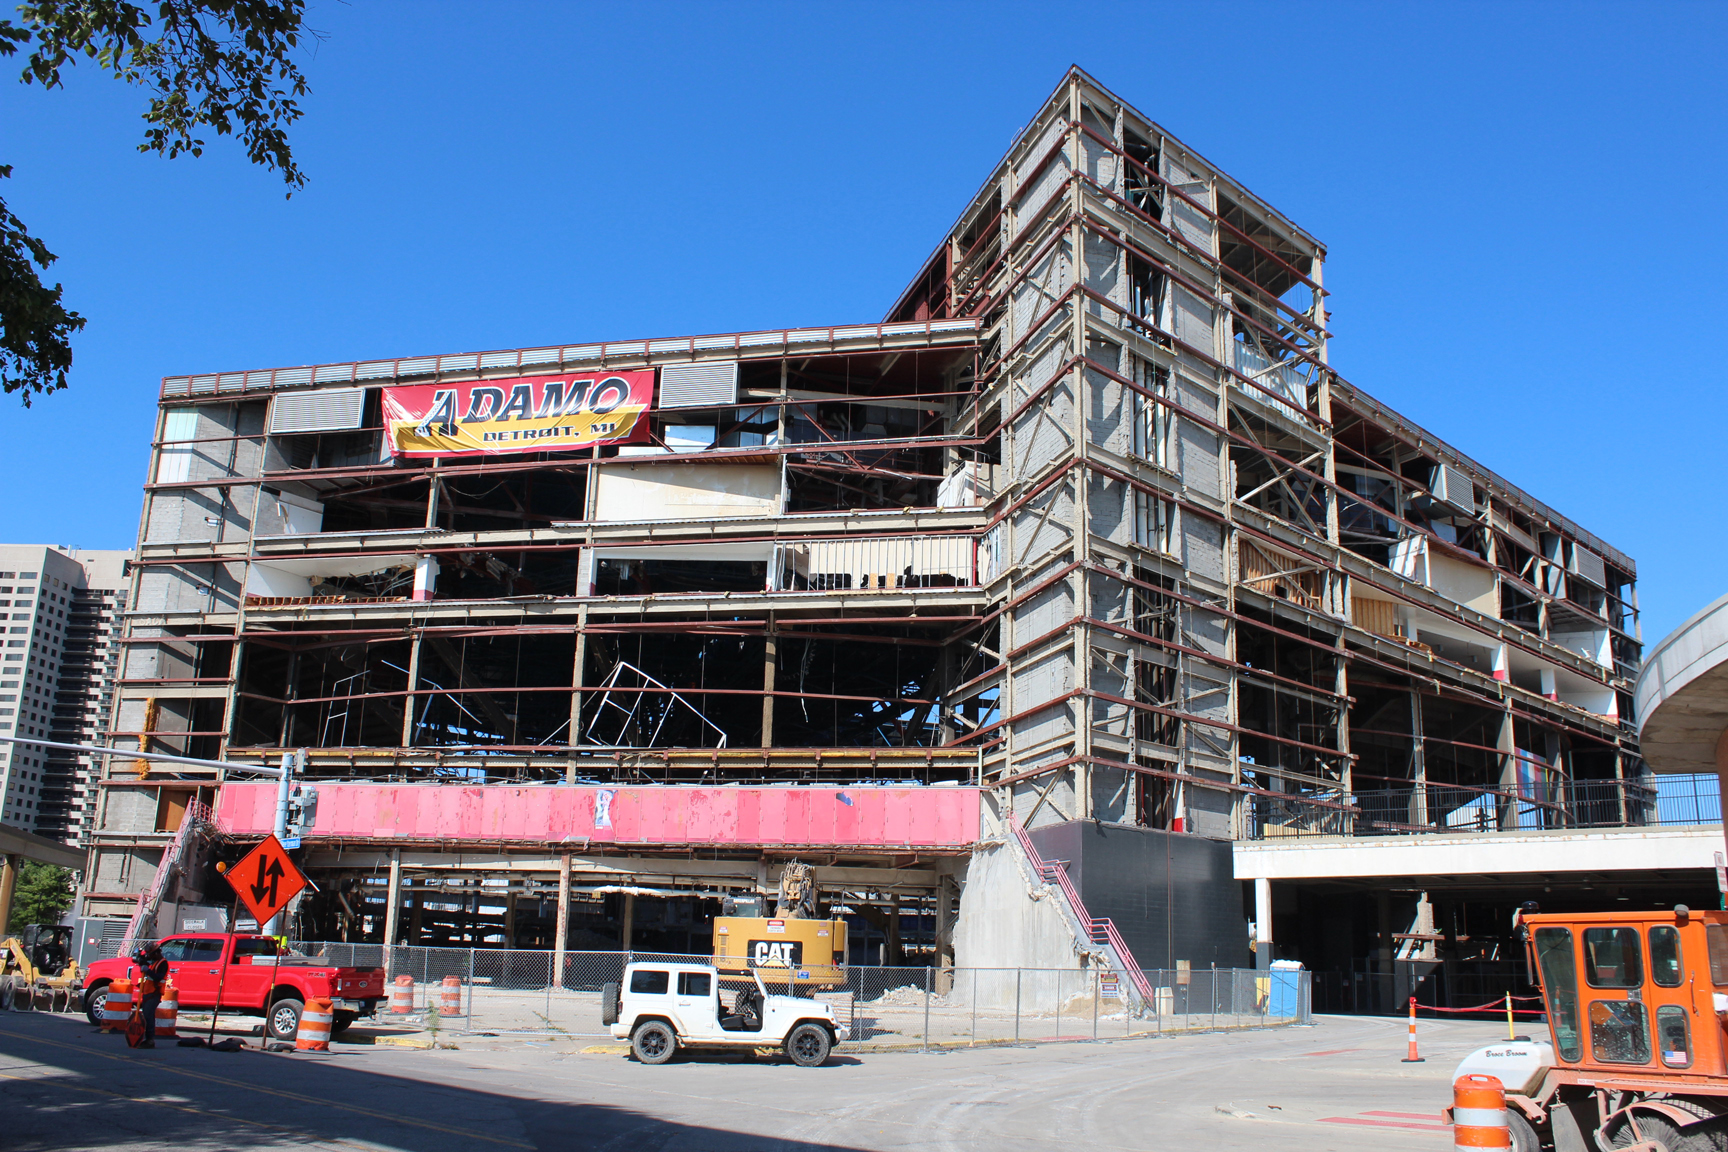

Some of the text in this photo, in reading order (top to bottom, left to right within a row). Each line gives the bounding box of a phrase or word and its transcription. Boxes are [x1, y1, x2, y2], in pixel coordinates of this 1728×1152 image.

[414, 377, 630, 437] ADAMO
[483, 422, 617, 442] DETROIT, MI
[755, 941, 794, 968] CAT
